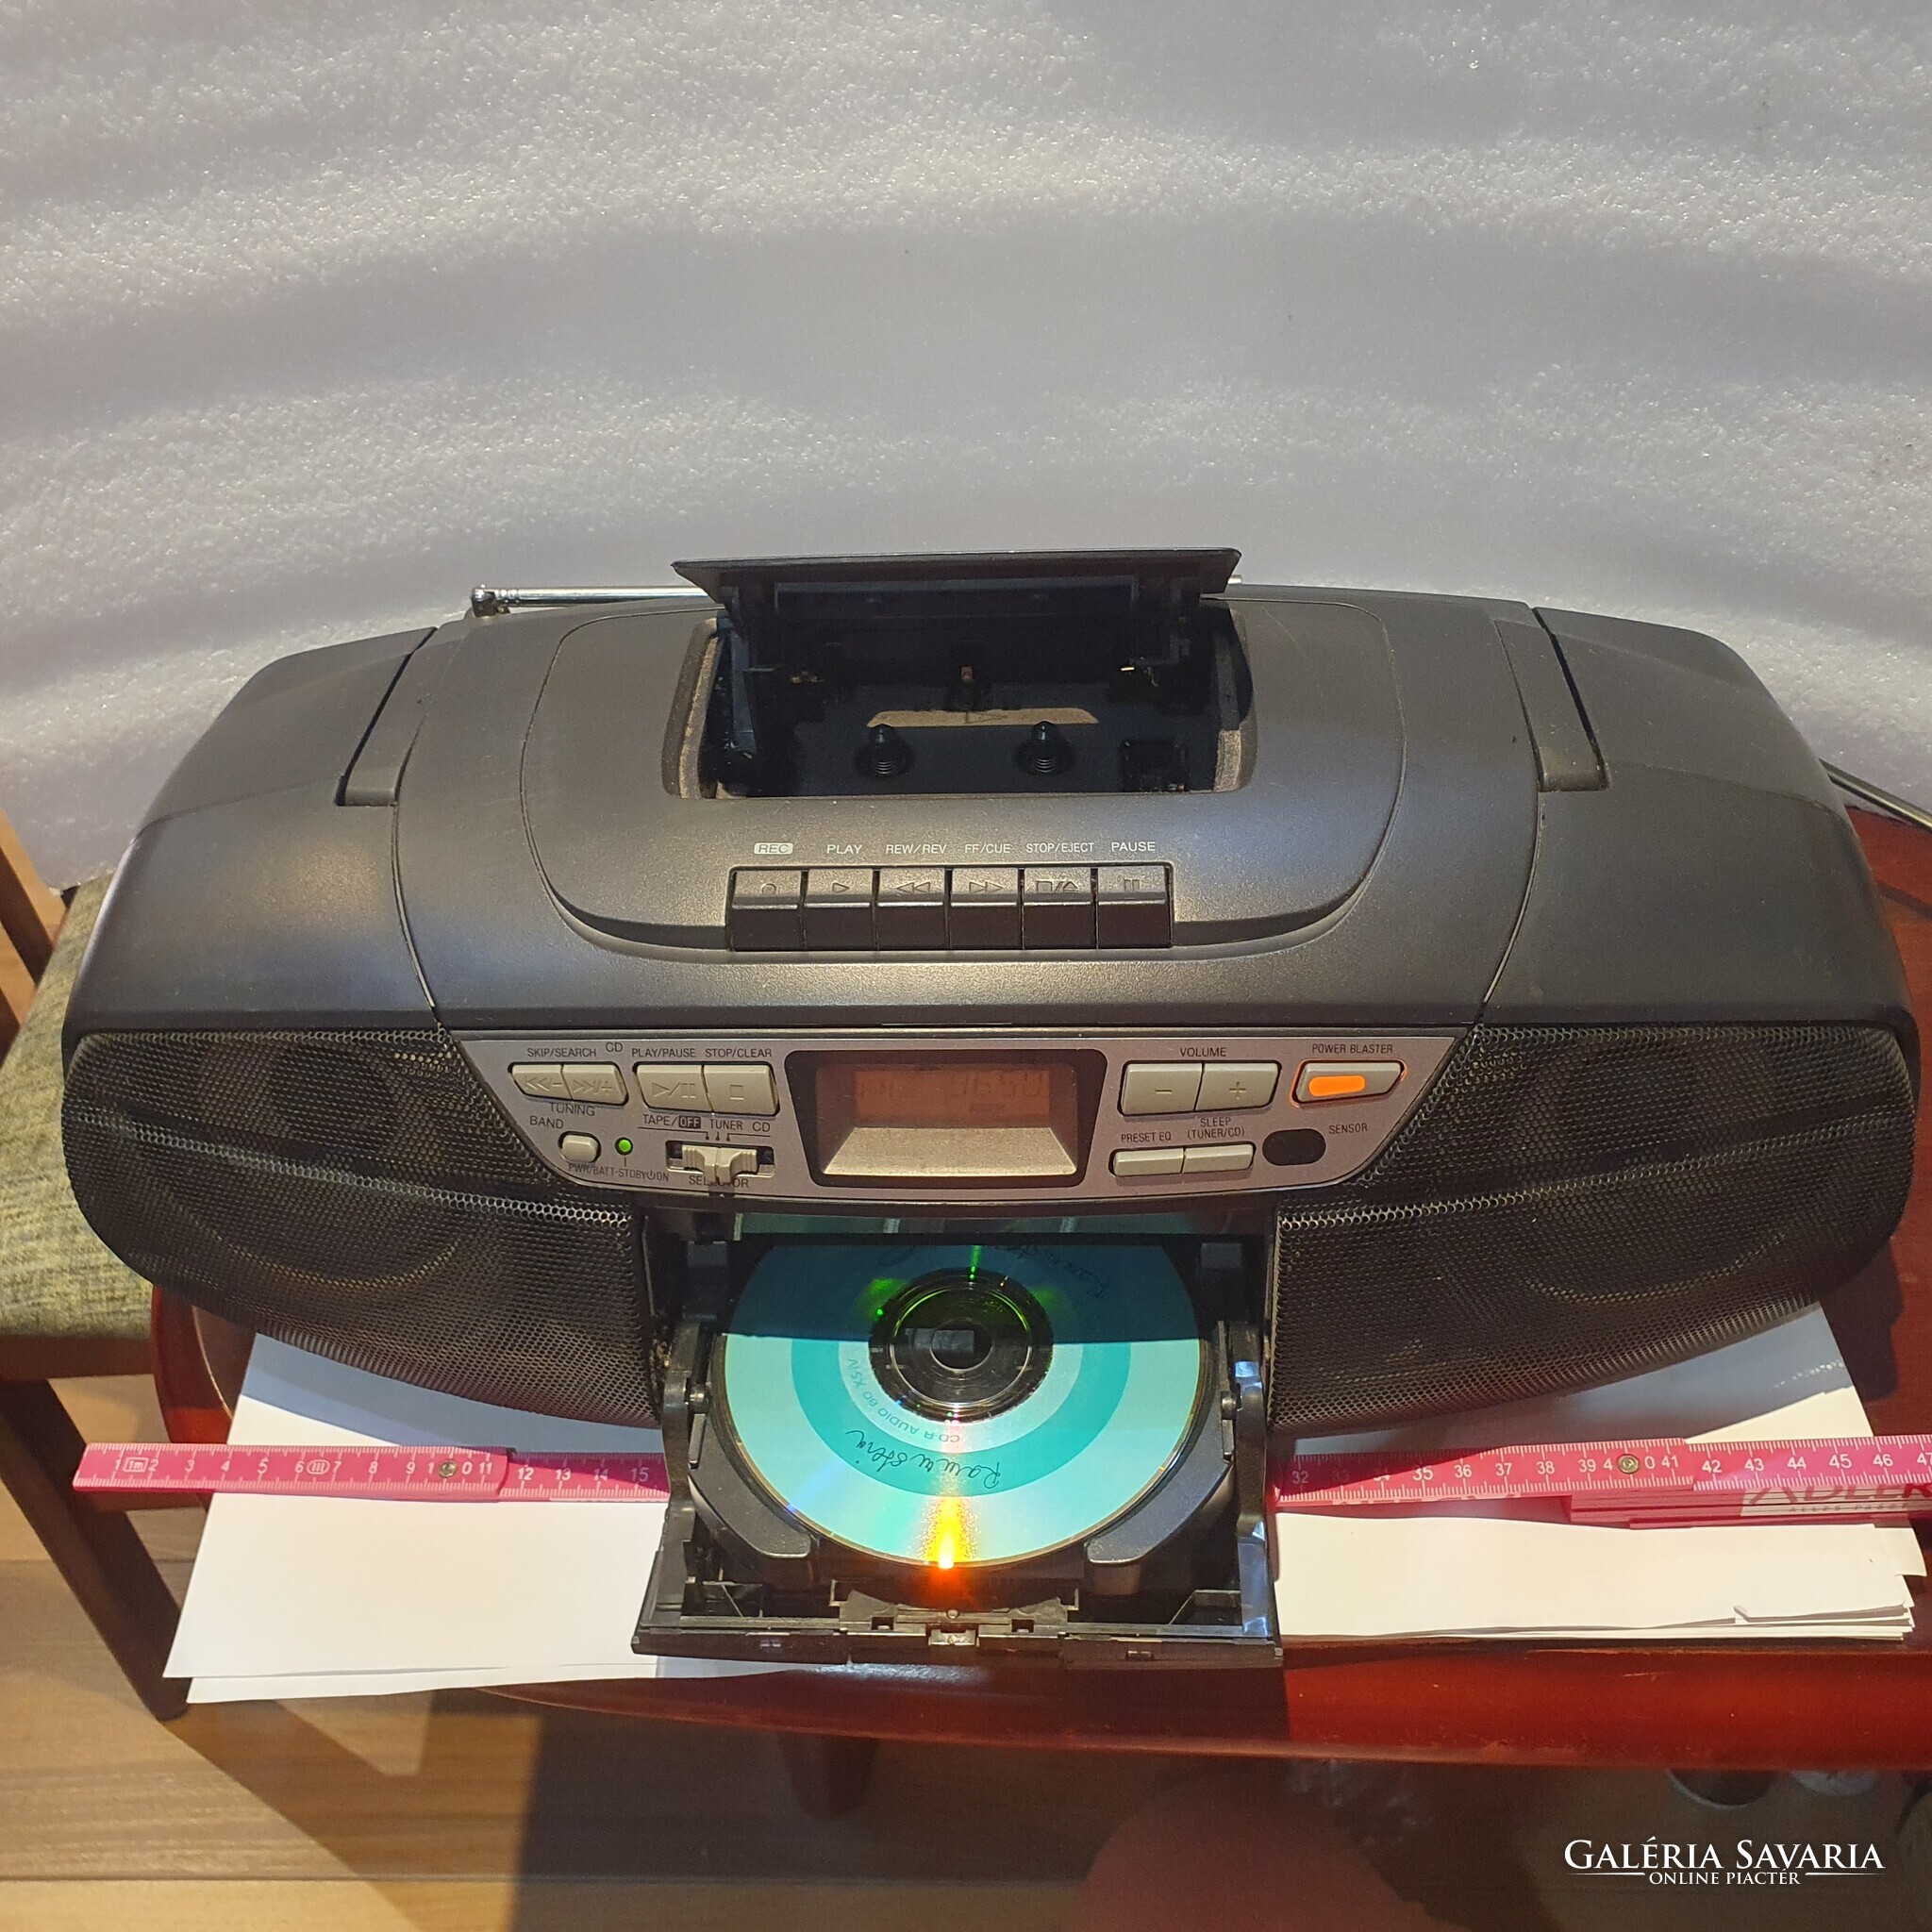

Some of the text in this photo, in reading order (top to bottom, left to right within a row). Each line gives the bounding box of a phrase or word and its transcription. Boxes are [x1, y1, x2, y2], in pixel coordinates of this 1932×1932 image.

[759, 843, 790, 854] REC
[826, 843, 863, 855] PLAY
[885, 842, 947, 855] REW/REV
[964, 842, 1012, 854] FF/CUE
[1024, 841, 1095, 854] STOP/EJECT
[1110, 841, 1157, 852] PAUSE
[526, 1047, 597, 1058] SKIP/SEARCH
[605, 1041, 624, 1054] CD
[631, 1047, 696, 1058] PLAY/PAUSE
[705, 1047, 773, 1058] STOP/CLEAR
[1179, 1046, 1227, 1058] VOLUME
[1311, 1043, 1393, 1055] POWER BLASTER
[550, 1102, 595, 1117] TUNING
[529, 1115, 564, 1130] BAND
[709, 1119, 743, 1130] TUNER
[752, 1121, 771, 1132] CD
[1199, 1116, 1232, 1128] SLEEP
[1187, 1125, 1245, 1140] (TUNER/CD)
[1328, 1123, 1368, 1134] SENSOR
[1121, 1131, 1172, 1143] PRESET EQ
[863, 1391, 878, 1407] 80
[878, 1408, 920, 1435] AUDIO
[924, 1430, 960, 1443] CD-R
[148, 1459, 159, 1472] 2
[184, 1459, 195, 1473] 3
[220, 1459, 231, 1472] 4
[258, 1459, 268, 1474] 5
[293, 1460, 304, 1473] 6
[332, 1460, 341, 1474] 7
[368, 1461, 377, 1474] 8
[407, 1461, 415, 1474] 9
[478, 1461, 492, 1474] 11
[517, 1467, 535, 1480] 12
[555, 1468, 572, 1480] 13
[592, 1468, 608, 1481] 14
[630, 1467, 650, 1482] 15
[1292, 1470, 1309, 1484] 32
[1412, 1467, 1434, 1481] 35
[1453, 1464, 1472, 1478] 36
[1495, 1462, 1513, 1476] 37
[1537, 1460, 1556, 1474] 38
[1577, 1459, 1596, 1474] 39
[1660, 1456, 1679, 1469] 41
[1702, 1460, 1723, 1474] 42
[1744, 1457, 1765, 1472] 43
[1787, 1456, 1807, 1471] 44
[1828, 1454, 1852, 1470] 45
[1873, 1454, 1893, 1468] 46
